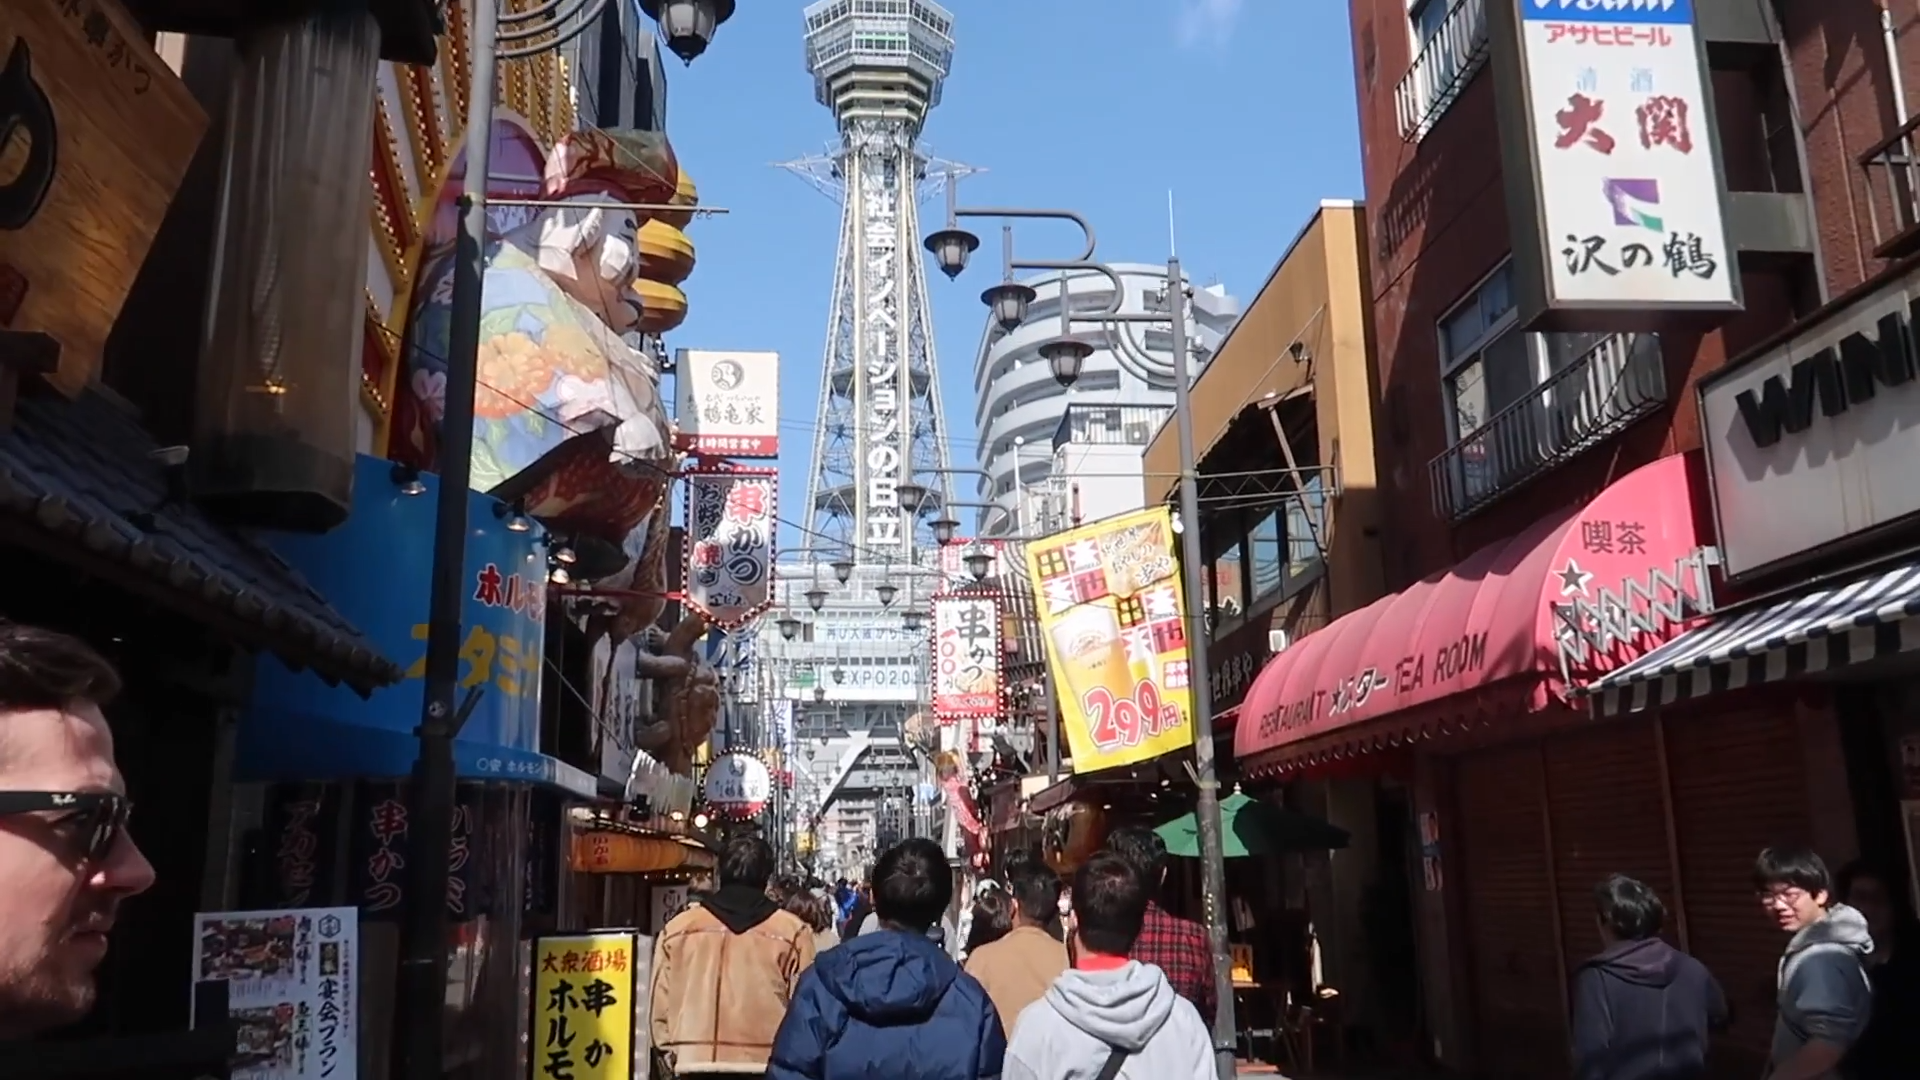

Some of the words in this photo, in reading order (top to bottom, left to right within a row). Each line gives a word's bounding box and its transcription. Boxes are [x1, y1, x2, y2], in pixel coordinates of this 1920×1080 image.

[1544, 23, 1672, 47] アサヒビール
[1576, 66, 1654, 92] 清酒
[1554, 93, 1693, 155] 大関
[1562, 231, 1717, 279] 沢の鶴
[864, 191, 902, 545] 社会イノベーションの日立
[1735, 295, 1920, 448] WIN
[727, 482, 765, 585] 串かつ
[1582, 520, 1647, 555] 喫茶
[955, 603, 993, 682] 串かつ
[1258, 690, 1326, 740] RESTAURANT
[1394, 656, 1424, 696] TEA
[1433, 632, 1488, 684] ROOM
[364, 799, 408, 911] 串かつ
[542, 948, 627, 974] 大衆酒場
[317, 978, 340, 1079] 宴会プラン
